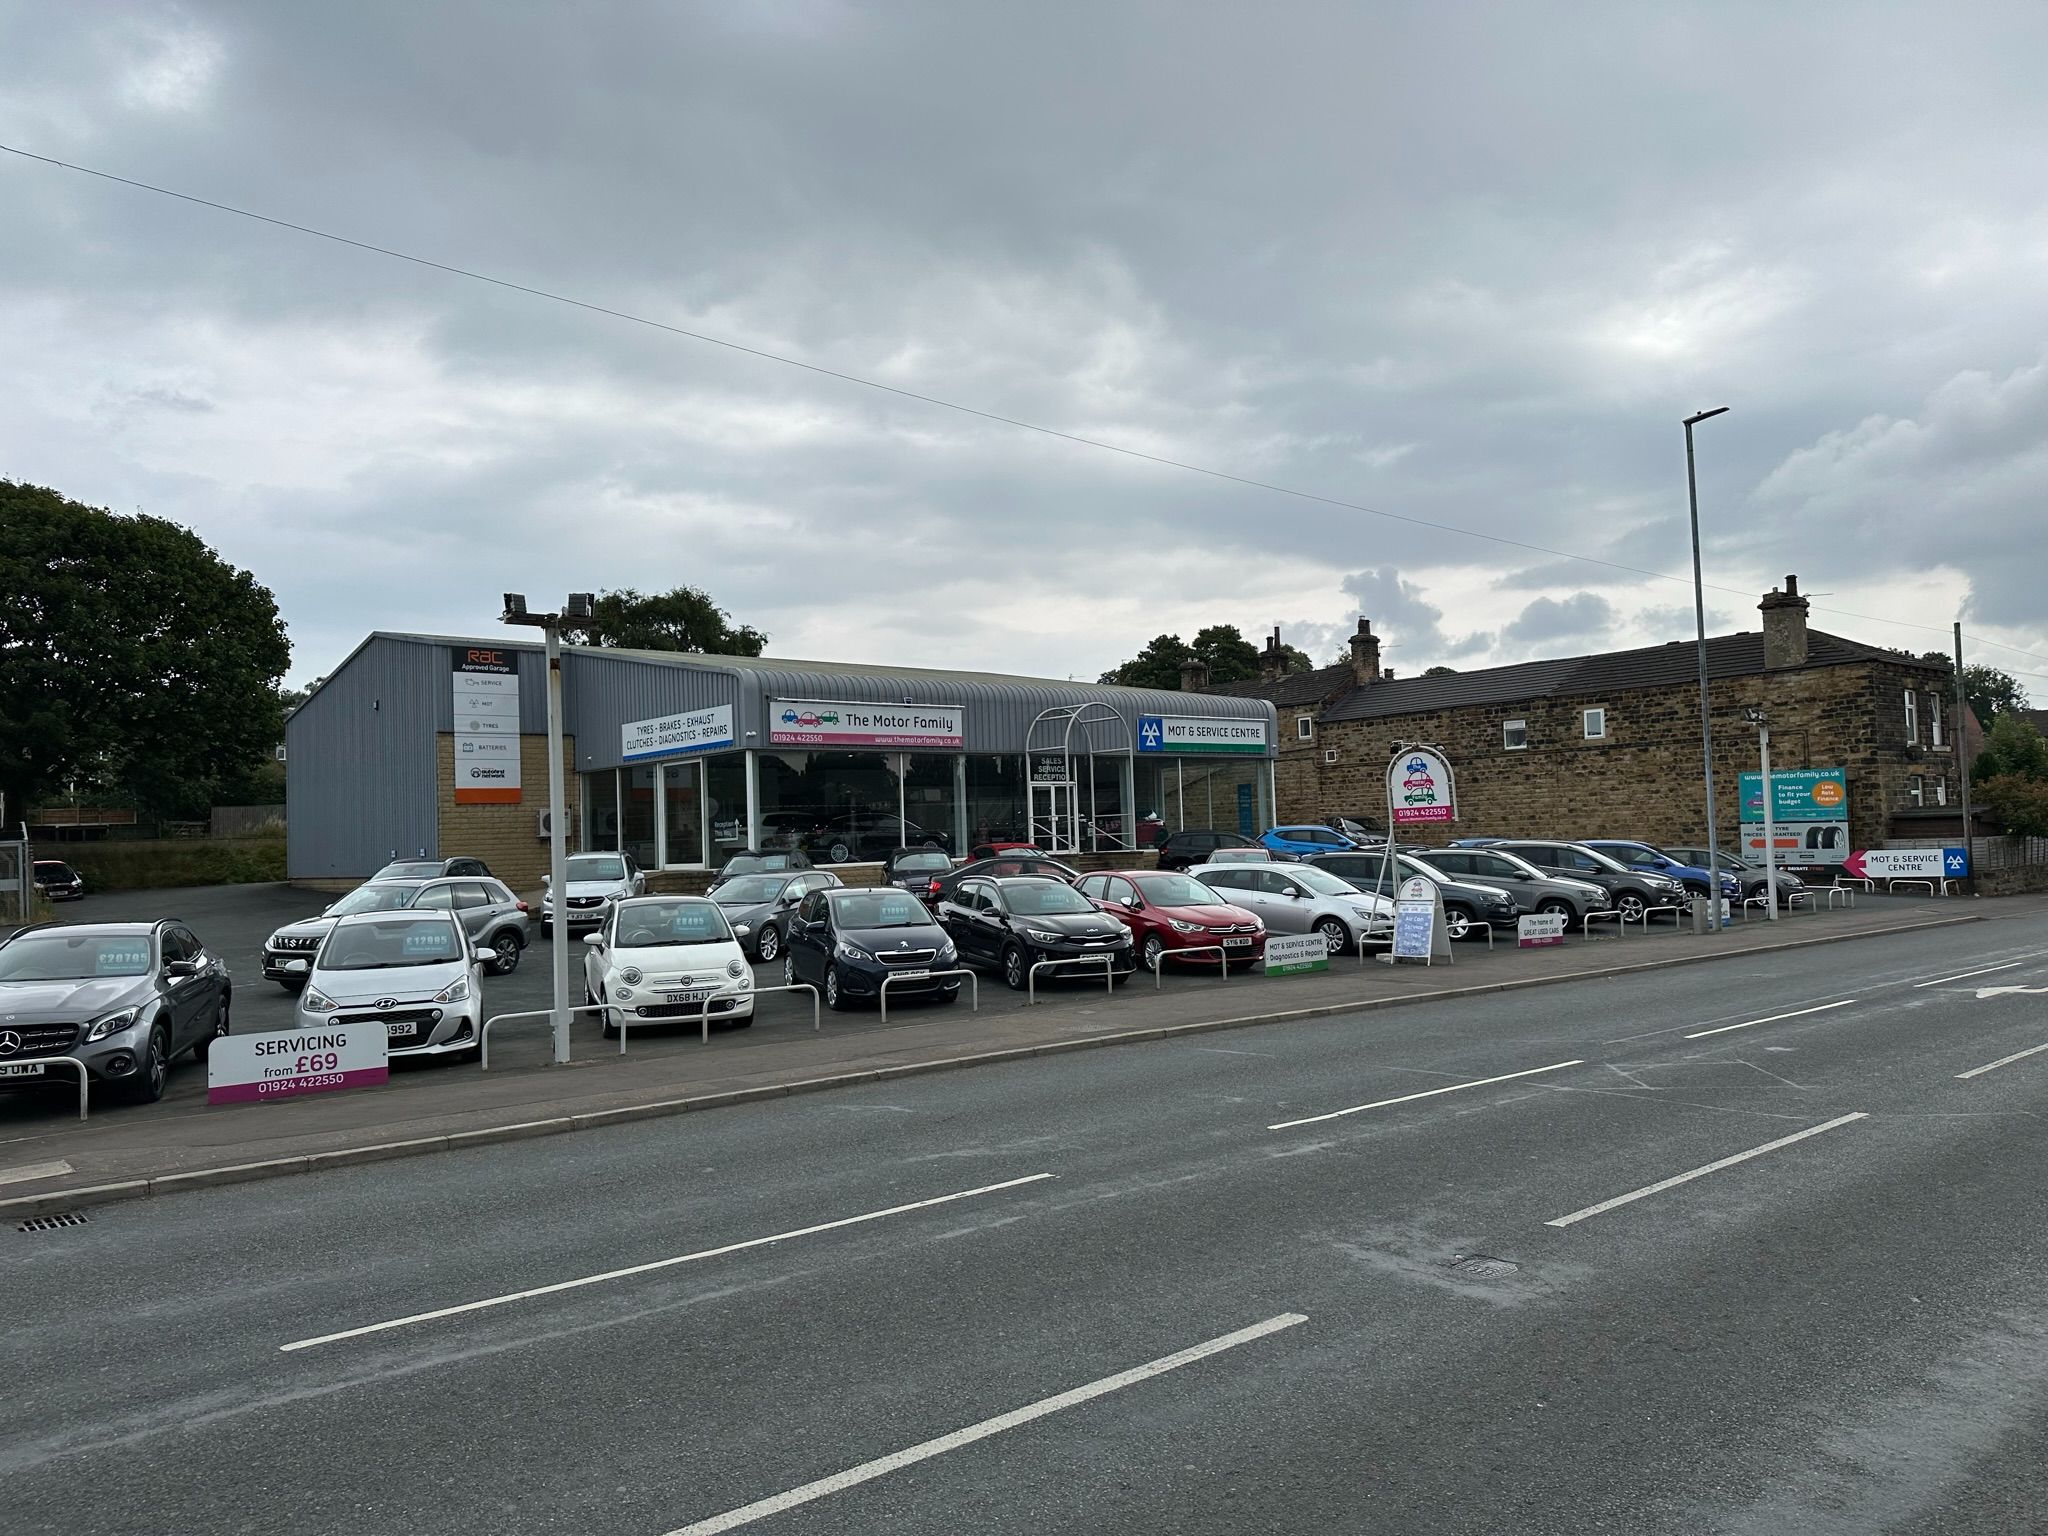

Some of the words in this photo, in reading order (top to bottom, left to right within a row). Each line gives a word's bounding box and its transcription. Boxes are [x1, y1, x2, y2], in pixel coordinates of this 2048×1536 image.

[462, 663, 489, 671] Approved
[490, 665, 510, 673] Garage
[636, 725, 654, 736] TYRES
[659, 720, 681, 732] BRAKES
[687, 713, 715, 728] EXHAUST
[846, 713, 869, 727] The
[873, 715, 910, 728] Motor
[914, 716, 953, 733] Family
[1168, 725, 1186, 736] MOT
[1188, 726, 1195, 737] &
[1196, 726, 1229, 738] SERVICE
[1231, 727, 1260, 739] CENTRE
[626, 737, 654, 751] CLUTCHES
[659, 730, 696, 745] DIAGNOSTICS
[702, 724, 728, 738] REPAIRS
[773, 733, 796, 742] 01924
[1041, 757, 1062, 765] SALES
[1038, 765, 1066, 773] SERVICE
[1033, 773, 1068, 781] RECEPTIO
[1796, 792, 1811, 800] your
[1398, 809, 1419, 817] 01924
[1420, 808, 1446, 816] 422550
[1904, 854, 1938, 862] SERVICE
[1888, 863, 1923, 871] CENTRE
[1286, 941, 1304, 949] SERVICE
[1305, 938, 1323, 946] CENTRE
[1270, 953, 1299, 961] Diagnostics
[1305, 949, 1324, 957] Repairs
[667, 993, 691, 1003] DX68
[255, 1034, 347, 1056] SERVICING
[264, 1066, 293, 1078] from
[295, 1052, 338, 1074] £69
[258, 1081, 296, 1093] 01924
[299, 1073, 344, 1087] 422550
